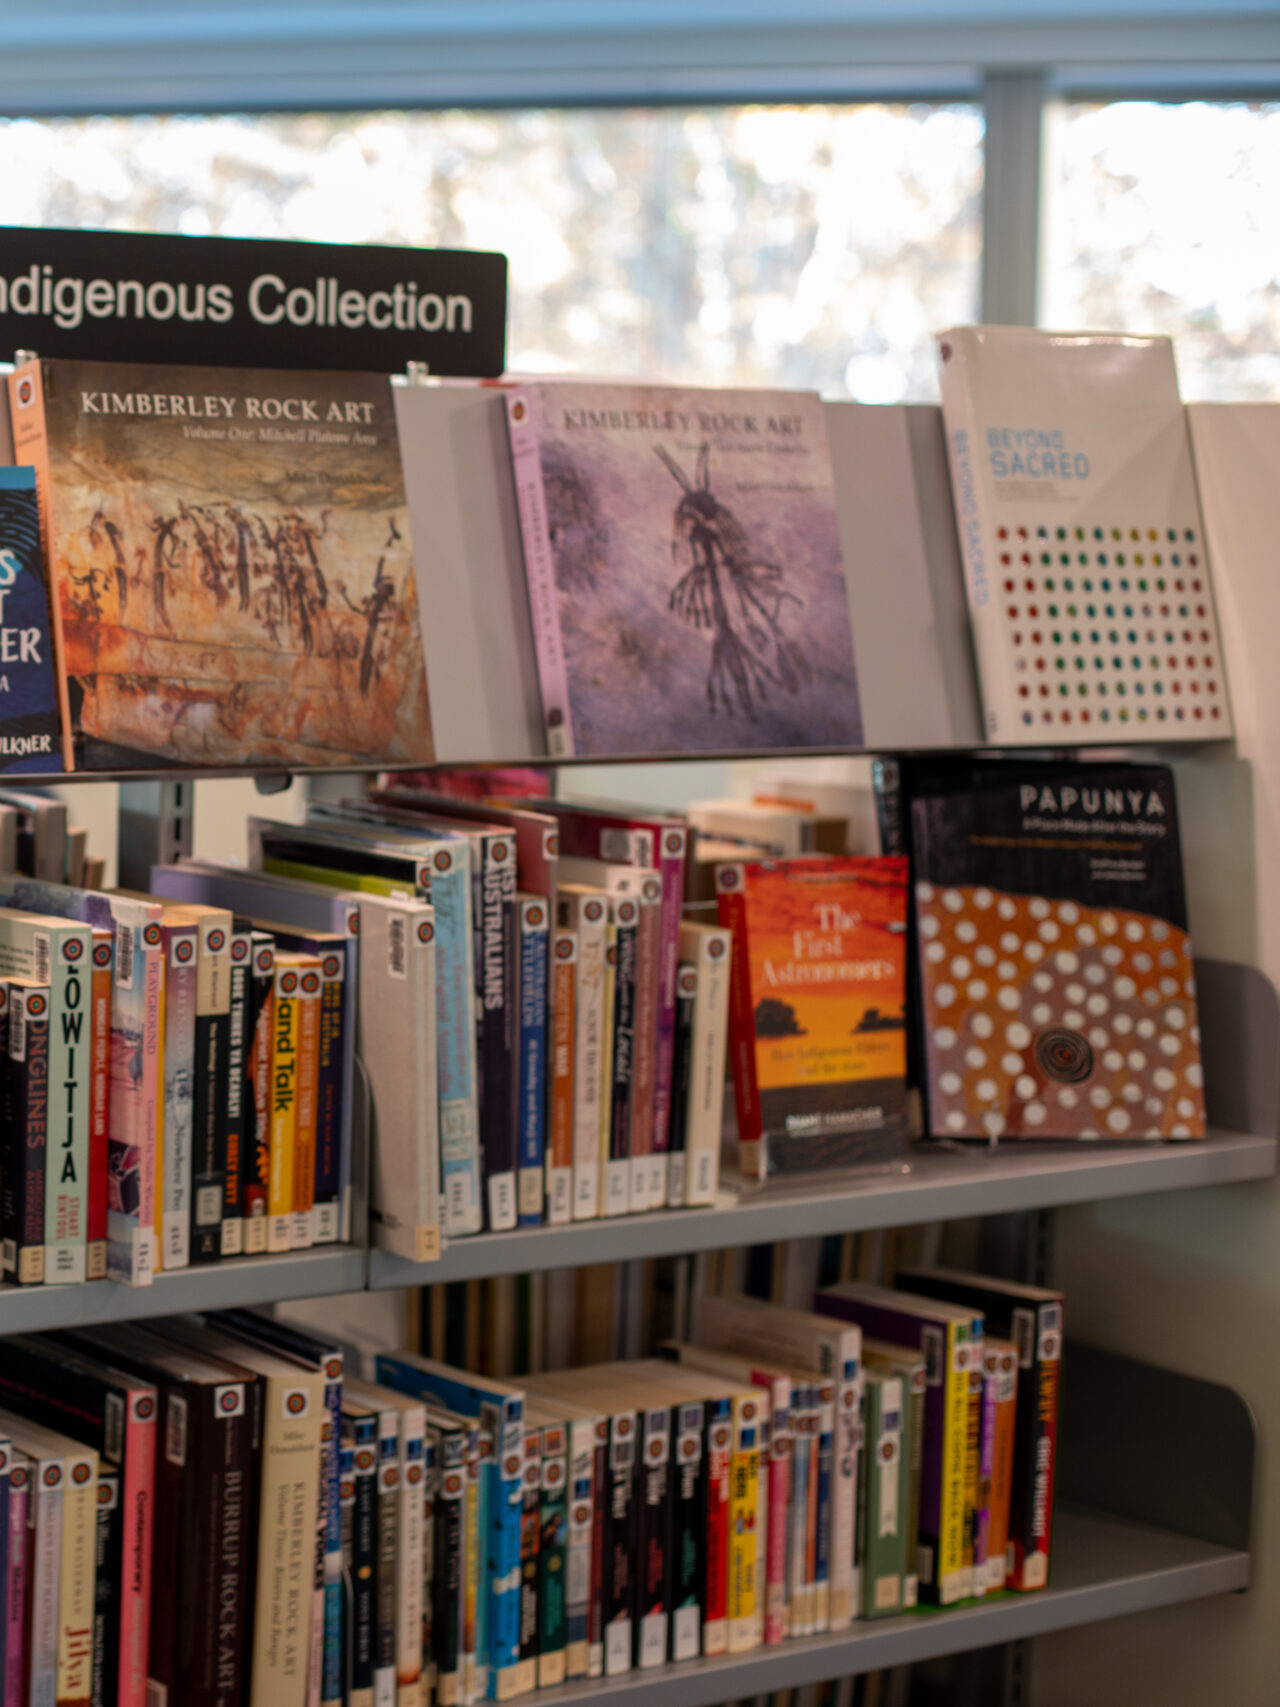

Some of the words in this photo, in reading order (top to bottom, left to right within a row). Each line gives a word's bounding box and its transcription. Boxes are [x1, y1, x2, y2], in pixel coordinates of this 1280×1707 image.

[247, 273, 473, 333] Collection
[80, 391, 237, 419] KIMBERLEY
[244, 397, 321, 422] ROCK
[325, 401, 376, 424] ART
[562, 408, 692, 432] KIMBERLEY
[697, 411, 759, 434] ROCK
[765, 414, 804, 435] ART
[986, 427, 1065, 450] BEYOND
[989, 450, 1091, 479] SACRED
[1019, 783, 1167, 817] PAPUNYA
[483, 868, 504, 1011] AUSTRALIANS
[813, 903, 862, 932] The
[792, 929, 843, 960] First
[760, 959, 897, 988] Astronomers
[146, 961, 158, 1056] PLAYGROUND
[275, 1000, 297, 1053] and
[26, 1021, 48, 1149] ONGLINES
[274, 1058, 297, 1113] Talk
[173, 1125, 185, 1187] Nowhere
[172, 1188, 183, 1212] Peo
[224, 1174, 238, 1204] TUTT
[71, 1196, 80, 1238] STUART
[131, 1490, 148, 1593] Contemporary
[222, 1470, 242, 1568] BURRUP
[287, 1481, 306, 1584] KIMBERLEY
[219, 1572, 239, 1639] ROCK
[284, 1588, 302, 1639] ROCK
[57, 1626, 93, 1689] Jilya
[216, 1645, 236, 1691] ART
[281, 1644, 298, 1678] ART
